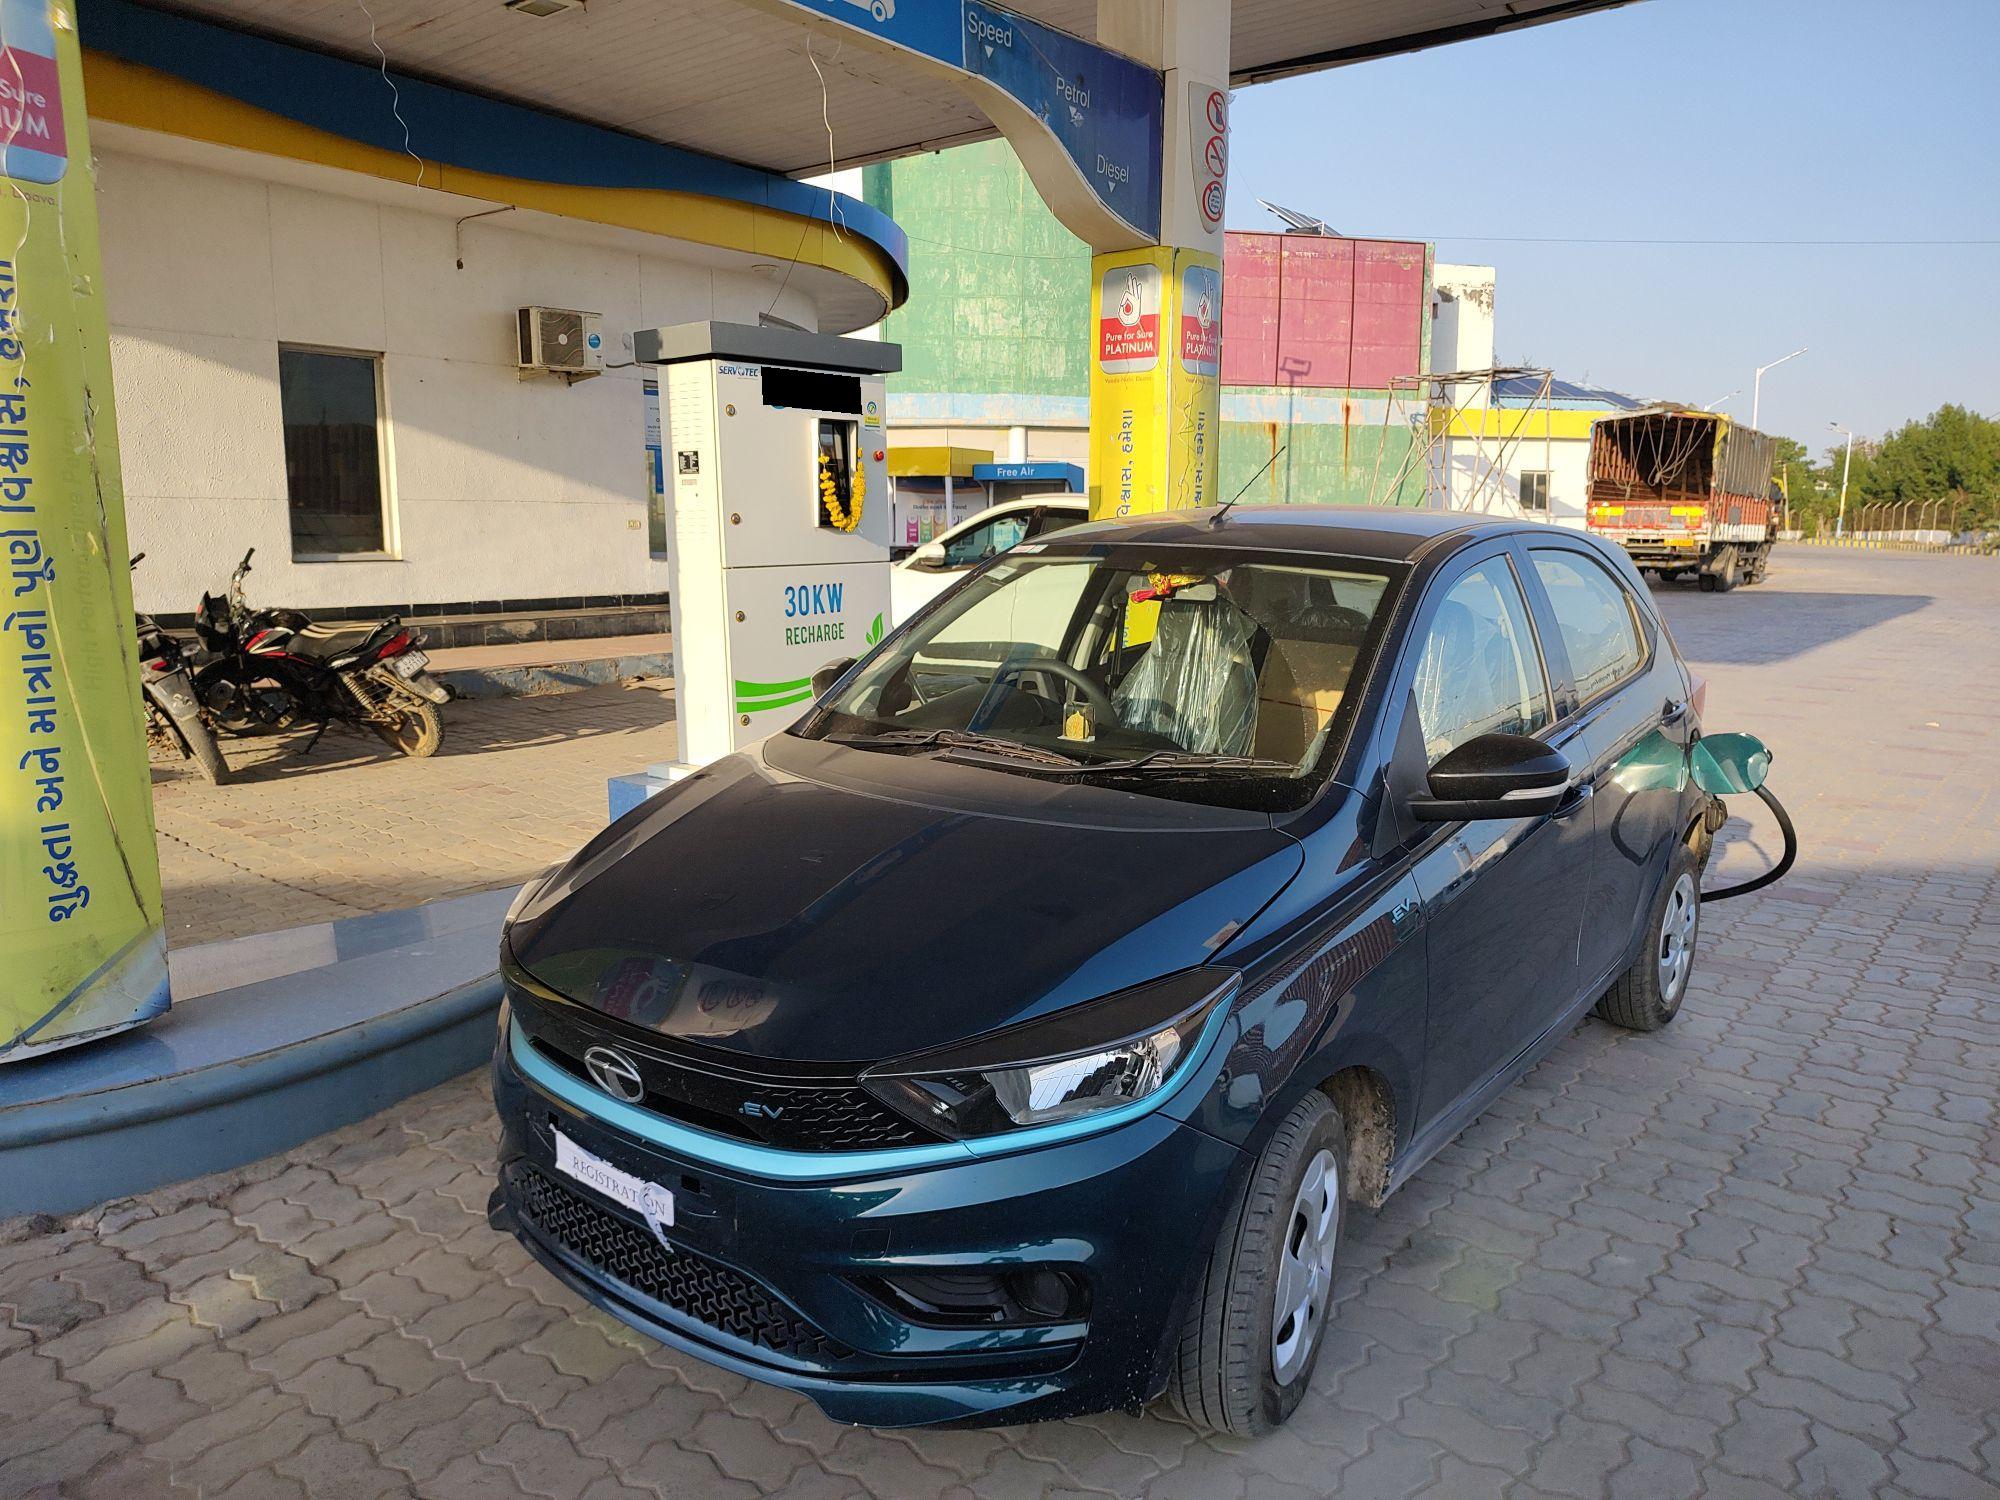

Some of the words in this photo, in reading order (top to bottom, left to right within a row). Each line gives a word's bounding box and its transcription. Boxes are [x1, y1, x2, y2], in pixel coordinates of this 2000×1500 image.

[967, 11, 1012, 48] Speed
[1056, 77, 1090, 109] Petrol
[1097, 154, 1129, 184] Diesel
[1105, 332, 1122, 342] Pure
[1124, 331, 1135, 340] for
[1136, 330, 1153, 339] Sure
[1105, 341, 1153, 356] PLATINUM
[1186, 331, 1200, 341] Pure
[997, 467, 1017, 477] Free
[1020, 466, 1035, 476] Air
[784, 582, 844, 618] 30KW
[785, 622, 845, 646] RECHARGE
[19, 746, 65, 814] અને
[573, 1155, 666, 1217] REGISTRATON
